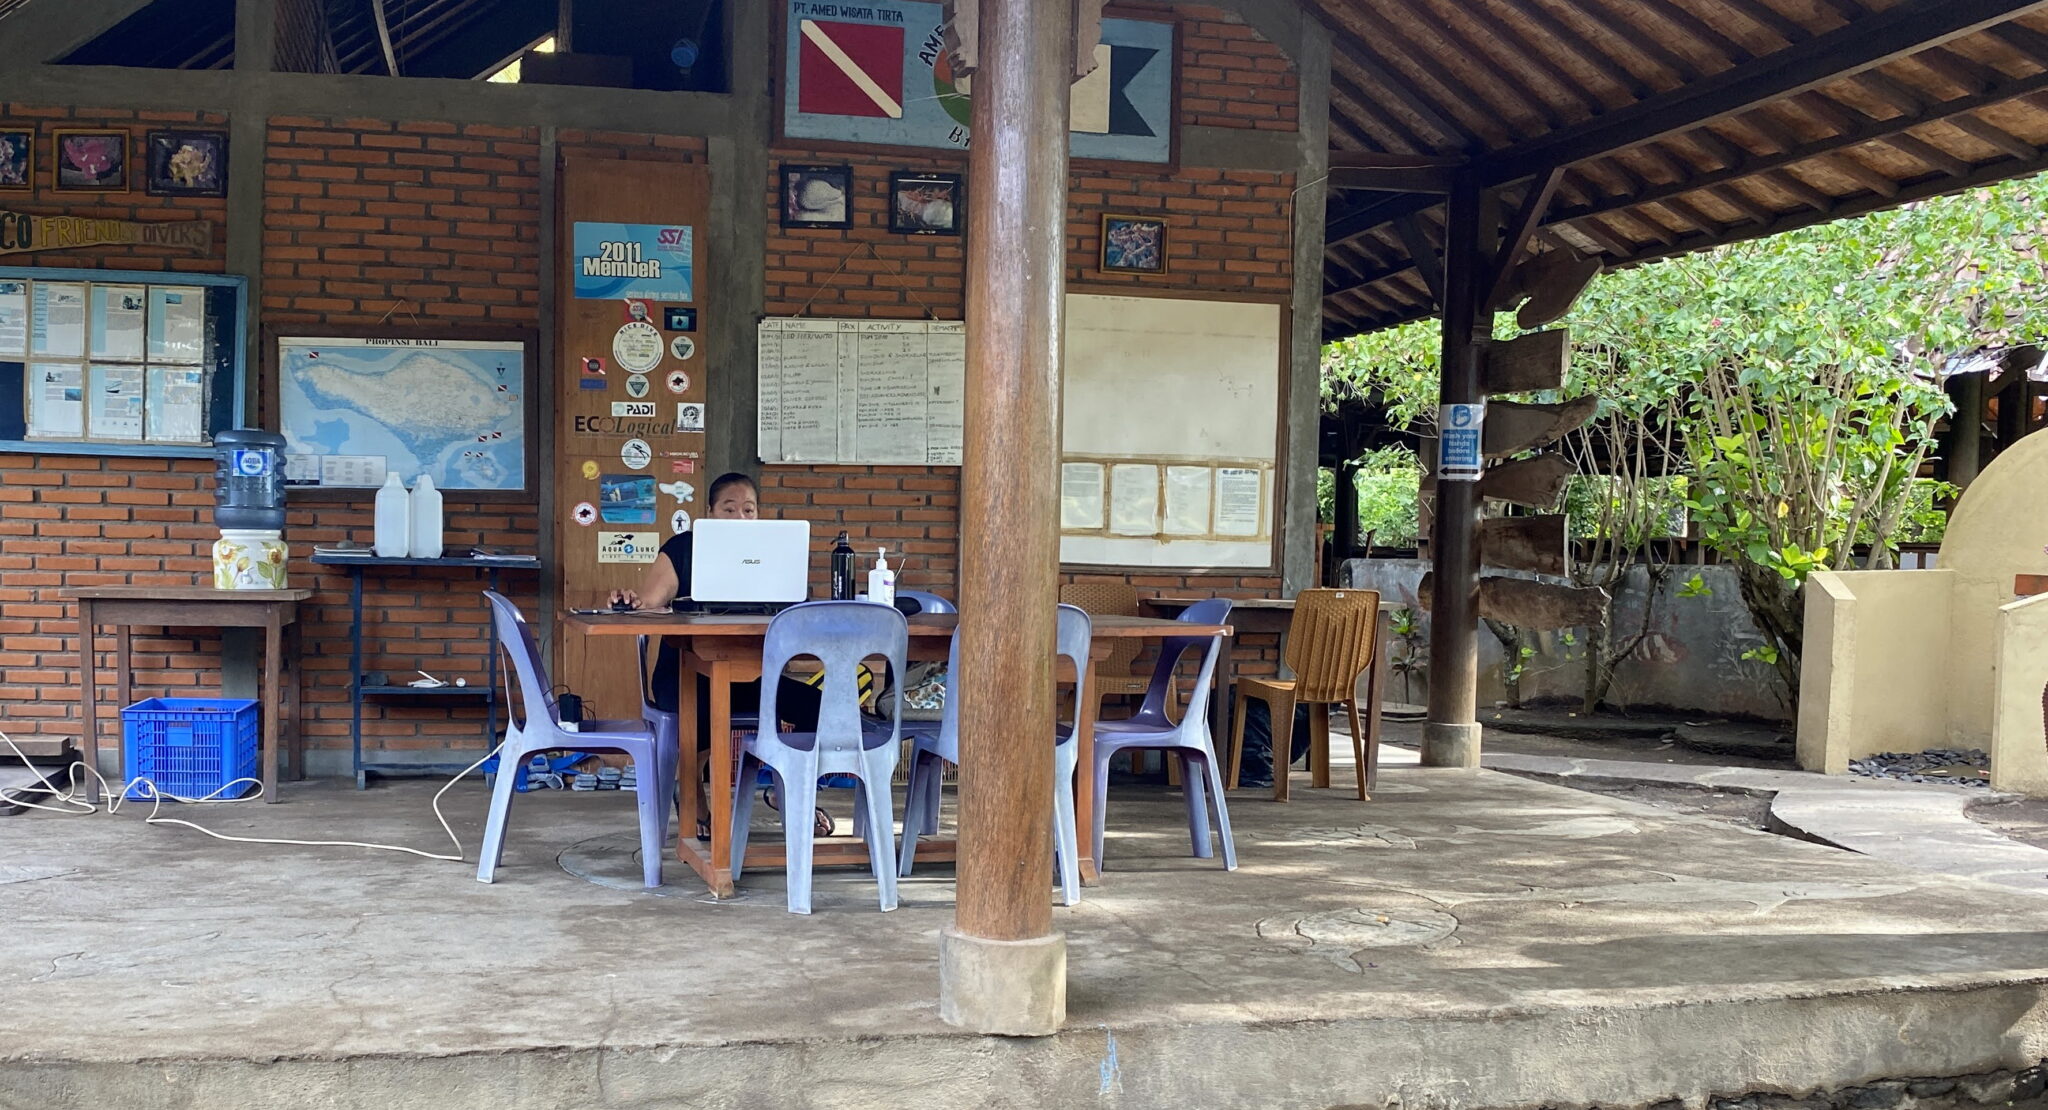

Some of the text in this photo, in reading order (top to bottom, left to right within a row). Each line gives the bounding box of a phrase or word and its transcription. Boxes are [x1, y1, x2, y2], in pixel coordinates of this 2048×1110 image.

[794, 2, 904, 22] PT. AMED WISATA TIRTA
[40, 217, 137, 247] FRIENDLY
[143, 222, 207, 245] DIVERS
[657, 229, 684, 245] SSI
[600, 241, 641, 262] 2011
[641, 323, 658, 336] DIVE
[763, 321, 779, 329] DATE
[626, 404, 654, 415] PADI
